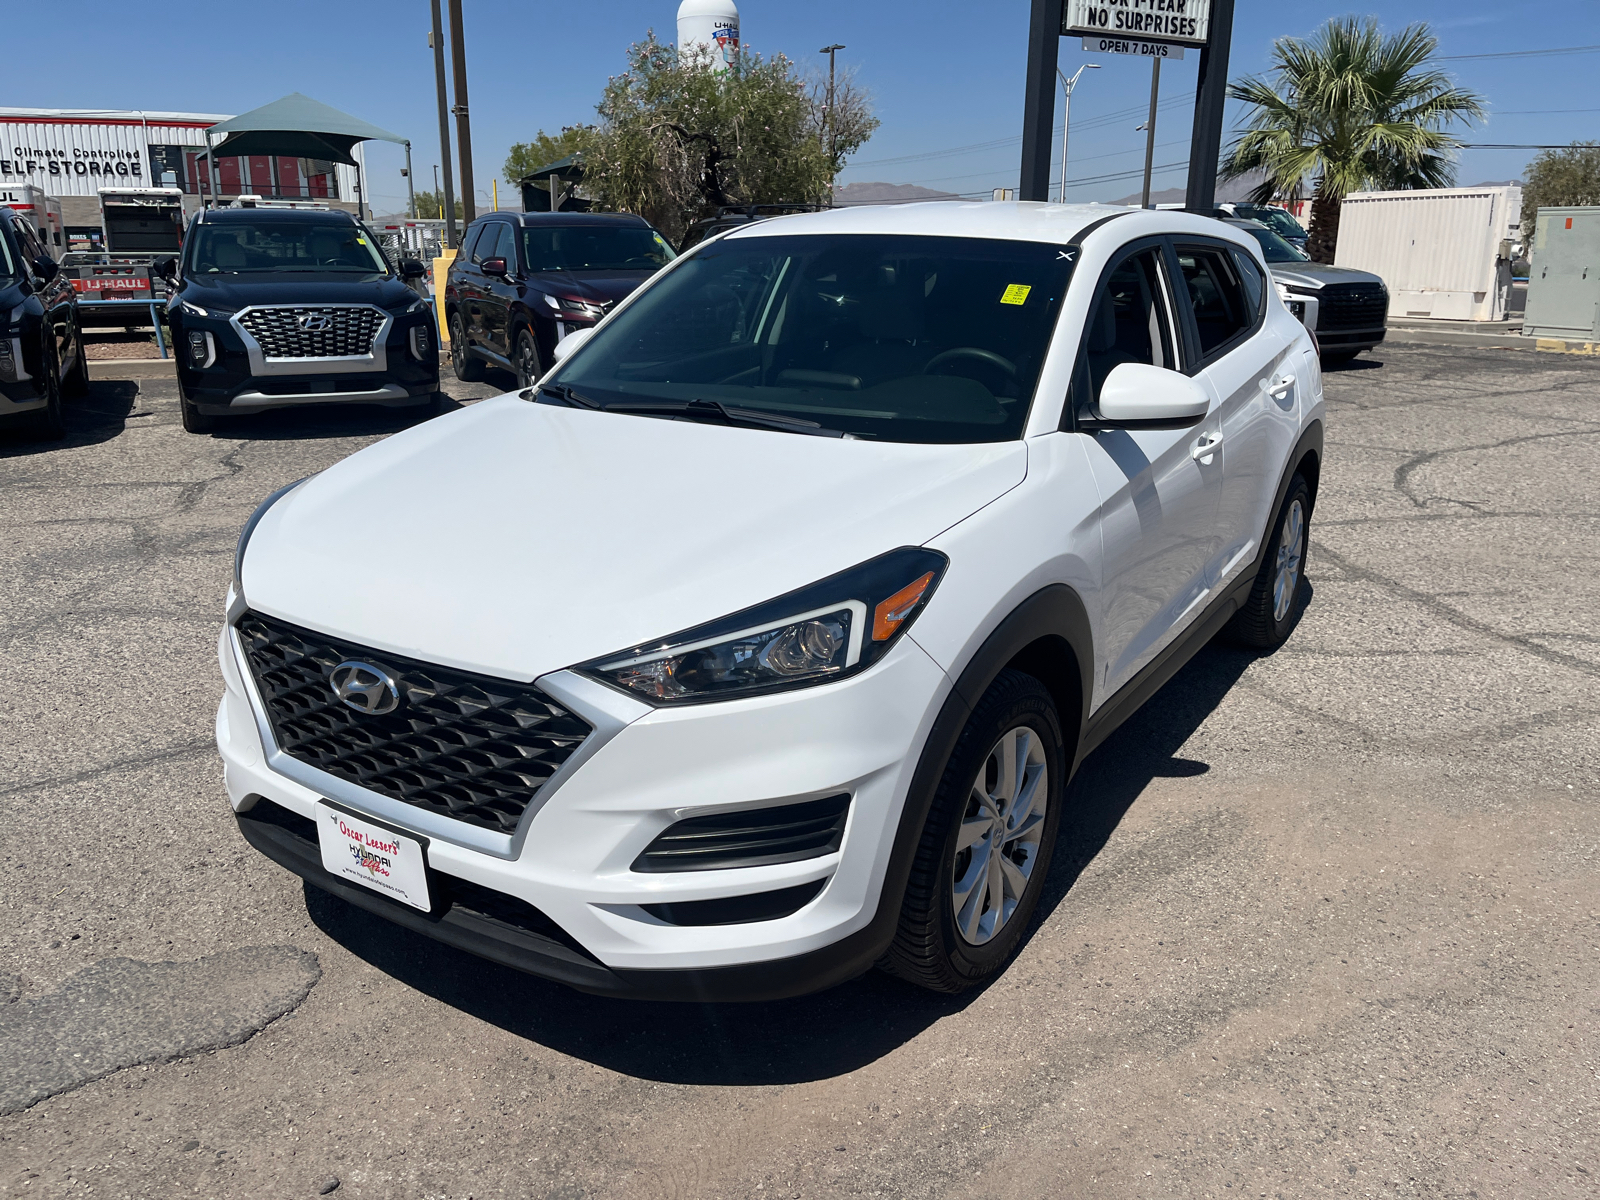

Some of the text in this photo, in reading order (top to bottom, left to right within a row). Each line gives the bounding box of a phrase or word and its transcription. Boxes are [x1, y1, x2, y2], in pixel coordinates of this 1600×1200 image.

[1088, 7, 1196, 36] NO SURPRISES
[1100, 39, 1168, 57] OPEN 7 DAYS
[14, 147, 140, 159] Climate Controlled
[1, 160, 142, 175] ELF-STORAGE
[86, 280, 146, 289] U-HAUL
[340, 821, 398, 855] Oscar Leeser's
[349, 843, 391, 868] HYUNDAI
